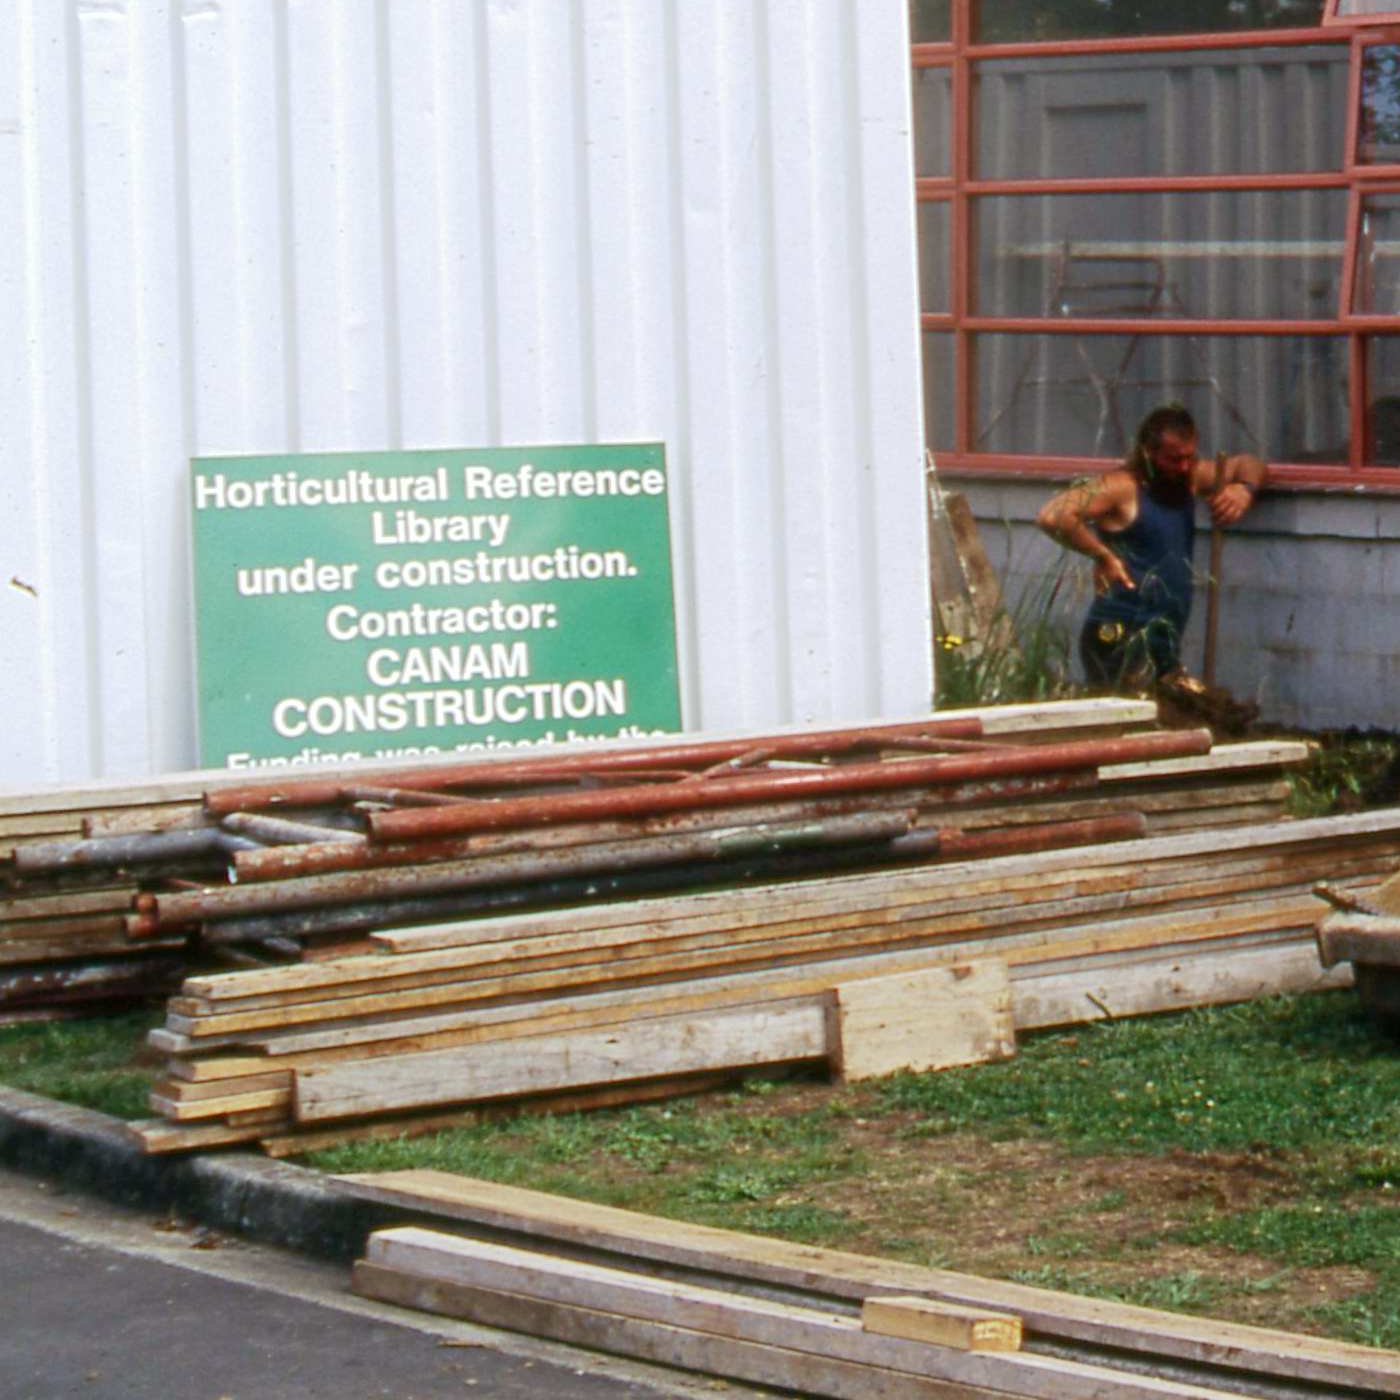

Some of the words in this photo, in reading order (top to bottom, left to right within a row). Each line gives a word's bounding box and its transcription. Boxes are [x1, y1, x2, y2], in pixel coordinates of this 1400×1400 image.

[195, 467, 449, 509] Horticultural
[464, 464, 665, 500] Reference
[372, 509, 510, 547] Library
[238, 557, 358, 595] under
[375, 546, 637, 589] construction.
[326, 599, 557, 640] Contractor:
[367, 642, 529, 686] CANAM
[273, 679, 626, 738] CONSTRUCTION
